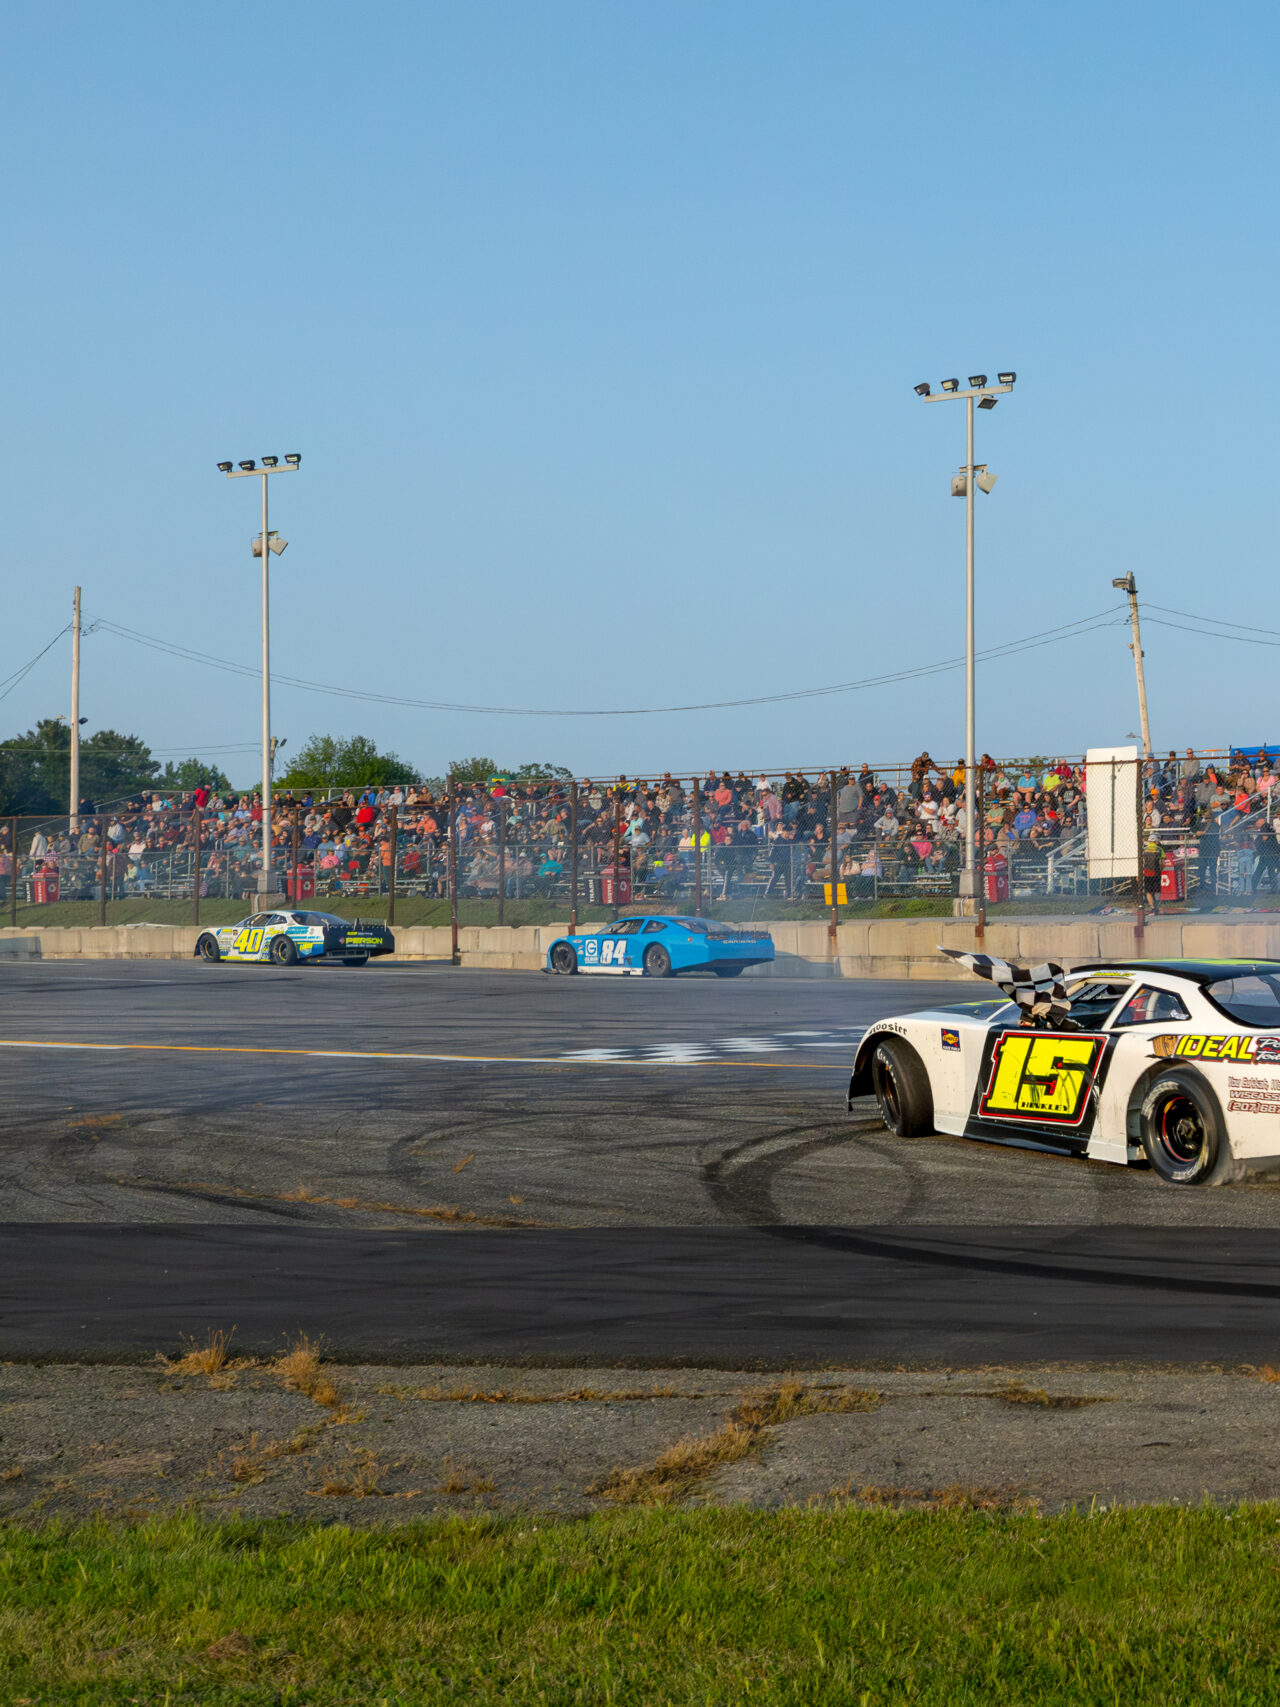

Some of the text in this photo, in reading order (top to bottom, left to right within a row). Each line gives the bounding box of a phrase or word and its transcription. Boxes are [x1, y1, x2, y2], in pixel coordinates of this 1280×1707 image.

[233, 928, 265, 954] 40
[600, 939, 628, 965] 84
[1176, 1034, 1254, 1061] IDEAL
[986, 1037, 1095, 1115] 15
[1021, 1101, 1070, 1112] HINKLEY
